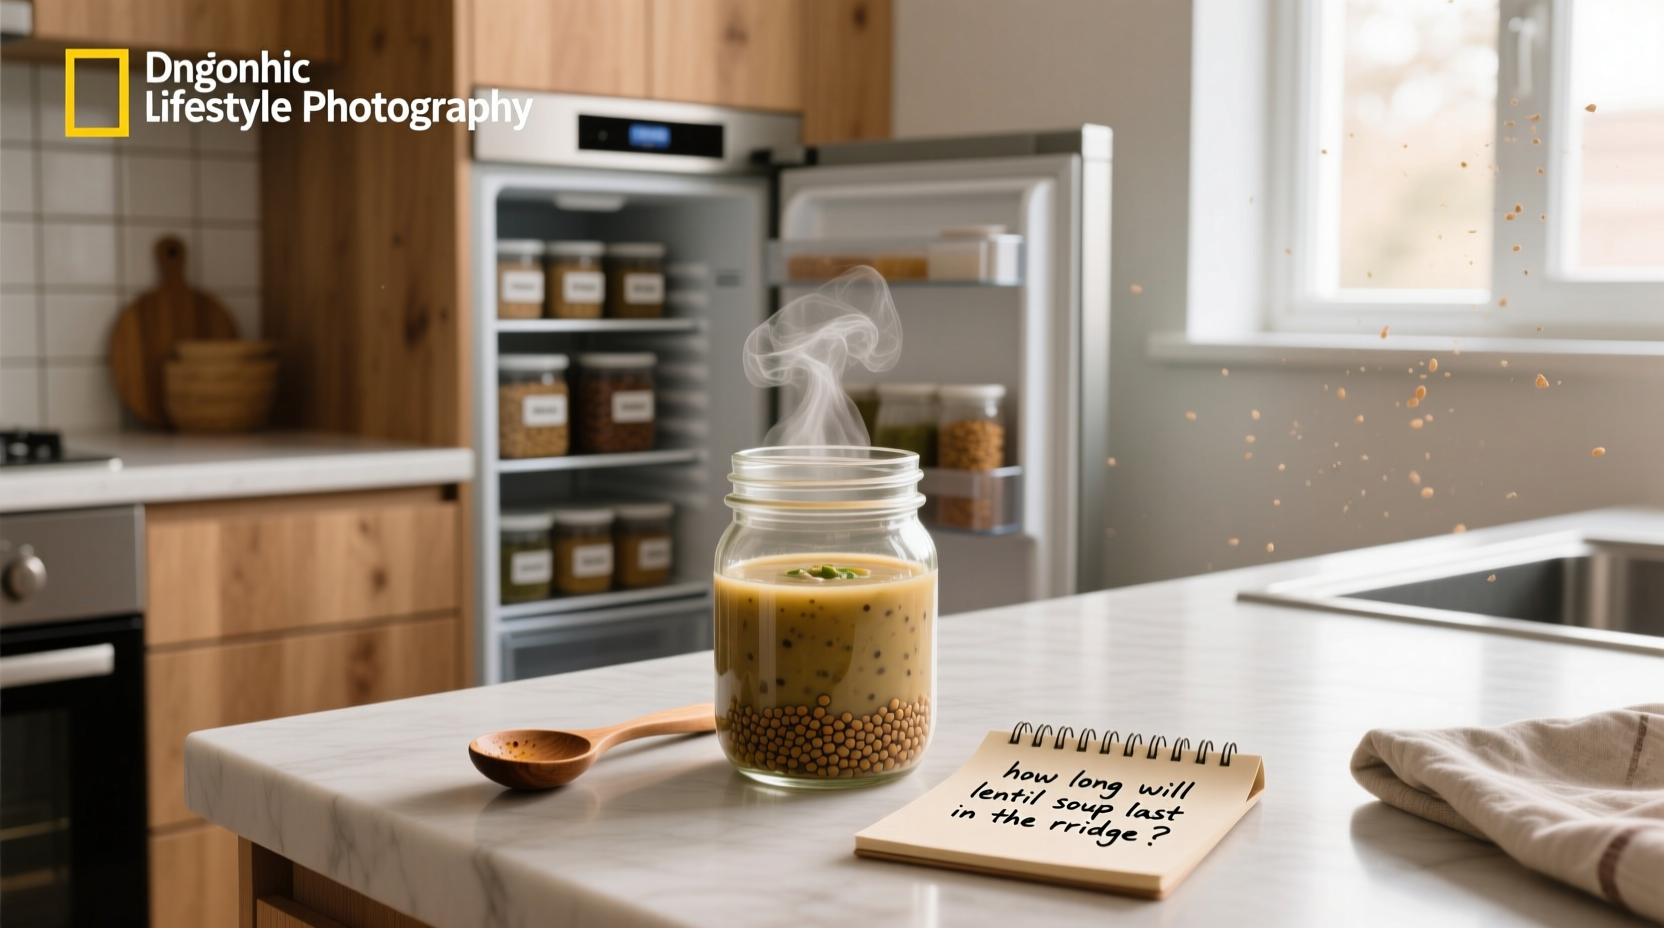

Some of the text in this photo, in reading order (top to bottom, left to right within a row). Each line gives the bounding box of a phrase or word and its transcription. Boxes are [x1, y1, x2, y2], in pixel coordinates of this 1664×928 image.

[1002, 760, 1196, 800] how long will
[950, 804, 976, 819] in
[991, 808, 1036, 828] the
[970, 781, 1185, 821] lentil soup last
